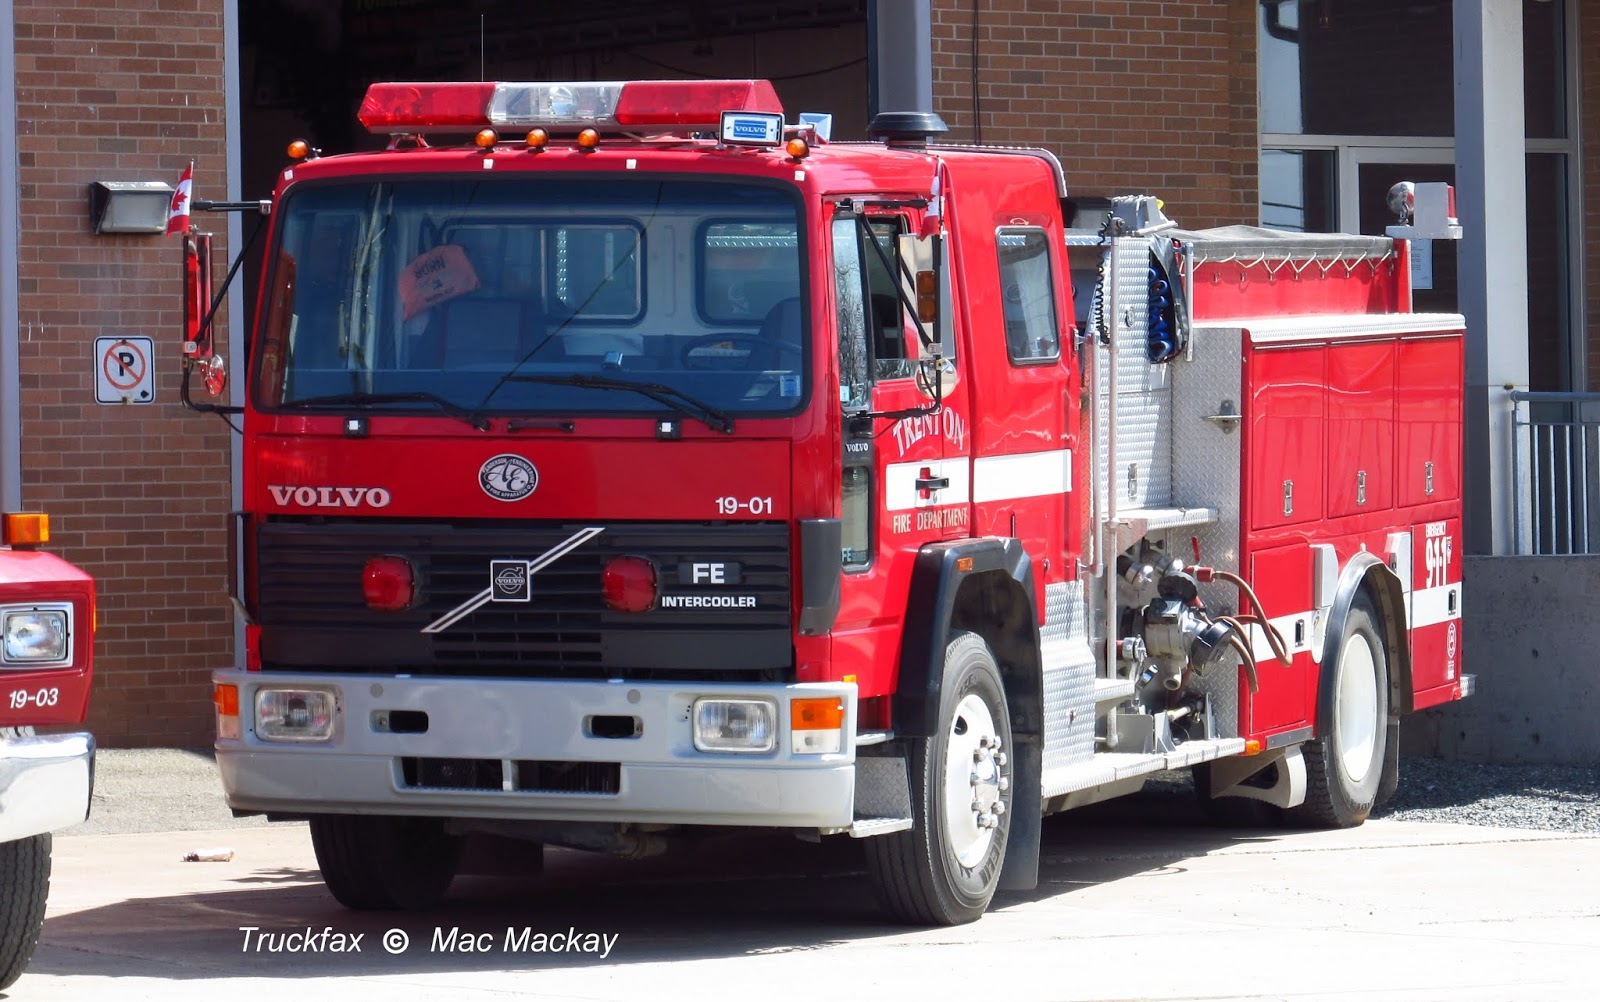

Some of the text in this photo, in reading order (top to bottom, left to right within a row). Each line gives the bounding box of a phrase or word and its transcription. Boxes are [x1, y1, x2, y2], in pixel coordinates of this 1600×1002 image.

[735, 125, 766, 133] VOLVO
[118, 352, 135, 377] P
[892, 401, 965, 458] TRENTON
[846, 443, 869, 453] VOLVO
[267, 485, 390, 508] VOLVO
[715, 496, 773, 515] 19-01
[893, 507, 968, 534] FIRE DEPARTMENT
[692, 563, 725, 584] FE
[661, 596, 756, 608] INTERCOOLER
[9, 687, 59, 709] 19-03
